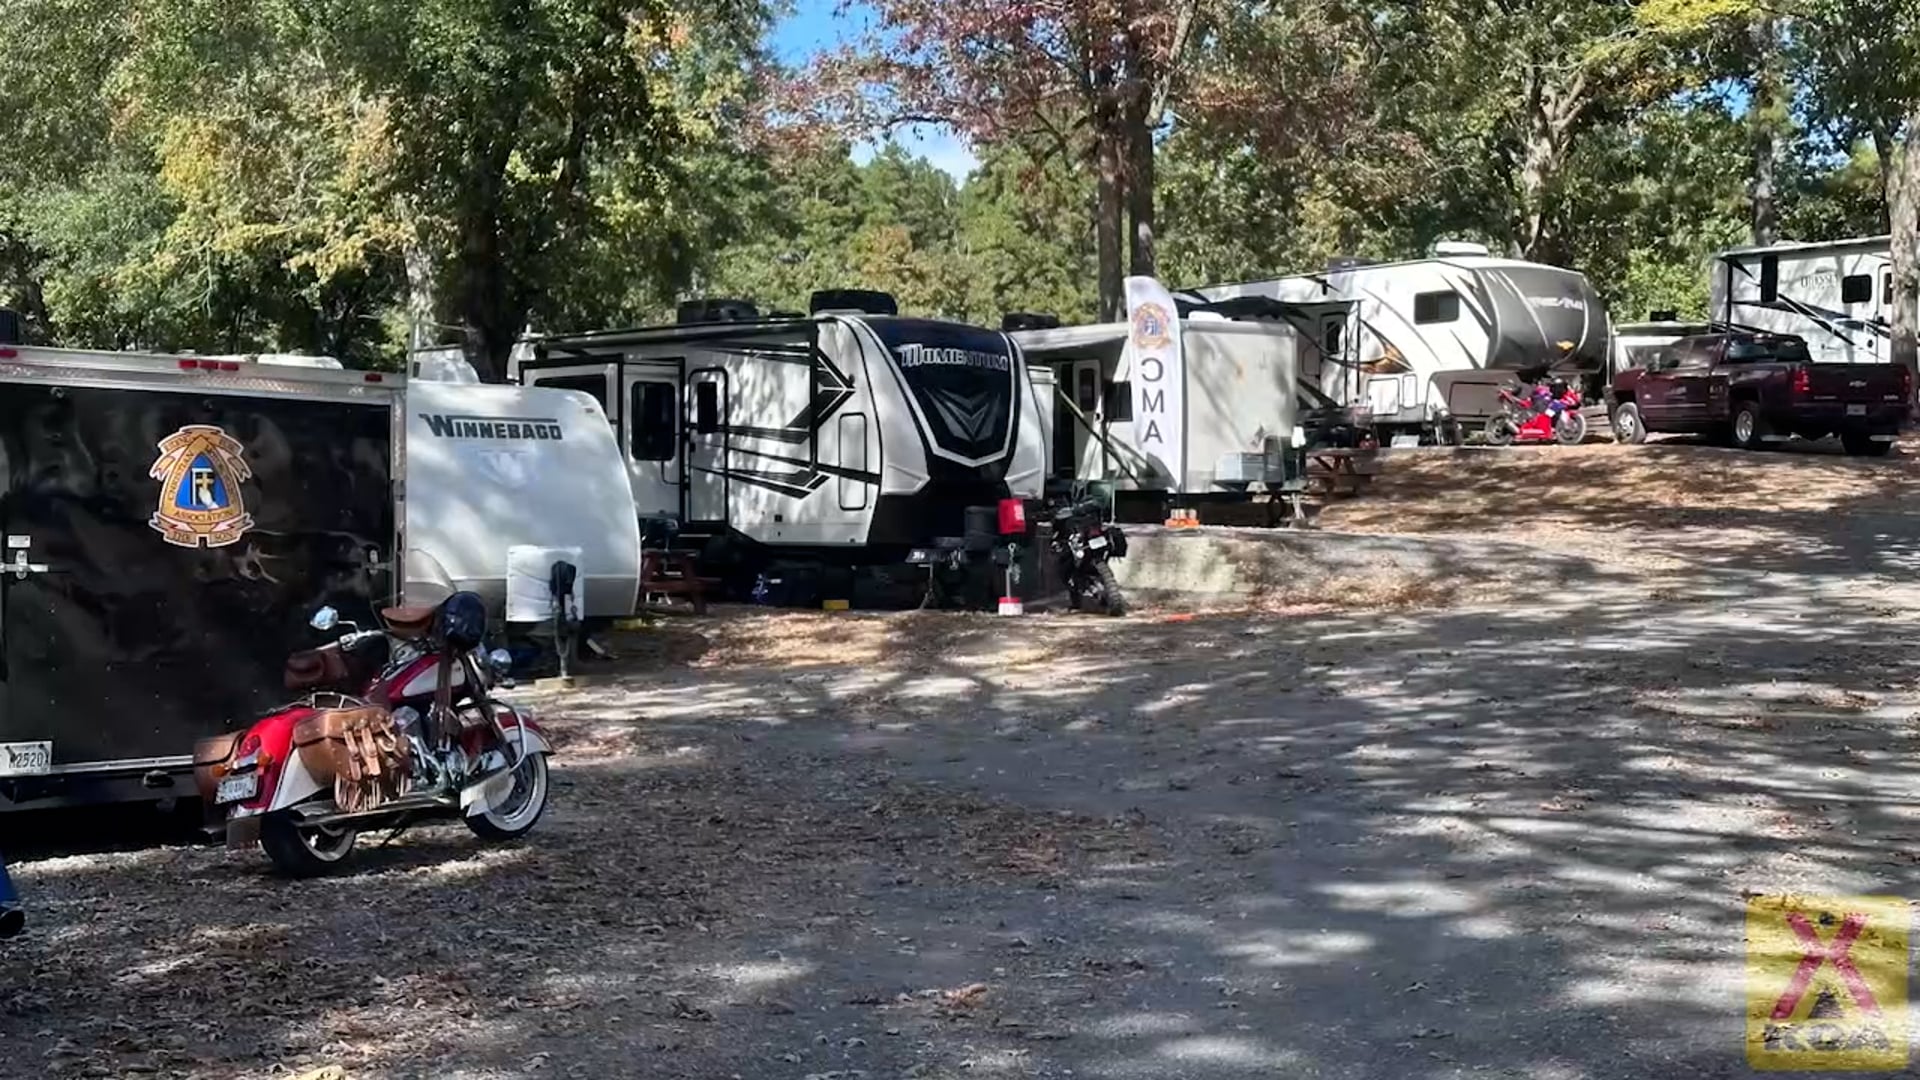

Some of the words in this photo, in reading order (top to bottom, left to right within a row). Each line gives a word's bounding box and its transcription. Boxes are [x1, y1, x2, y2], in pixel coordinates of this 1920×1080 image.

[893, 343, 1008, 371] MOMENTUM
[418, 413, 562, 441] WINNEBAGO
[174, 509, 235, 521] ASSOCIATION
